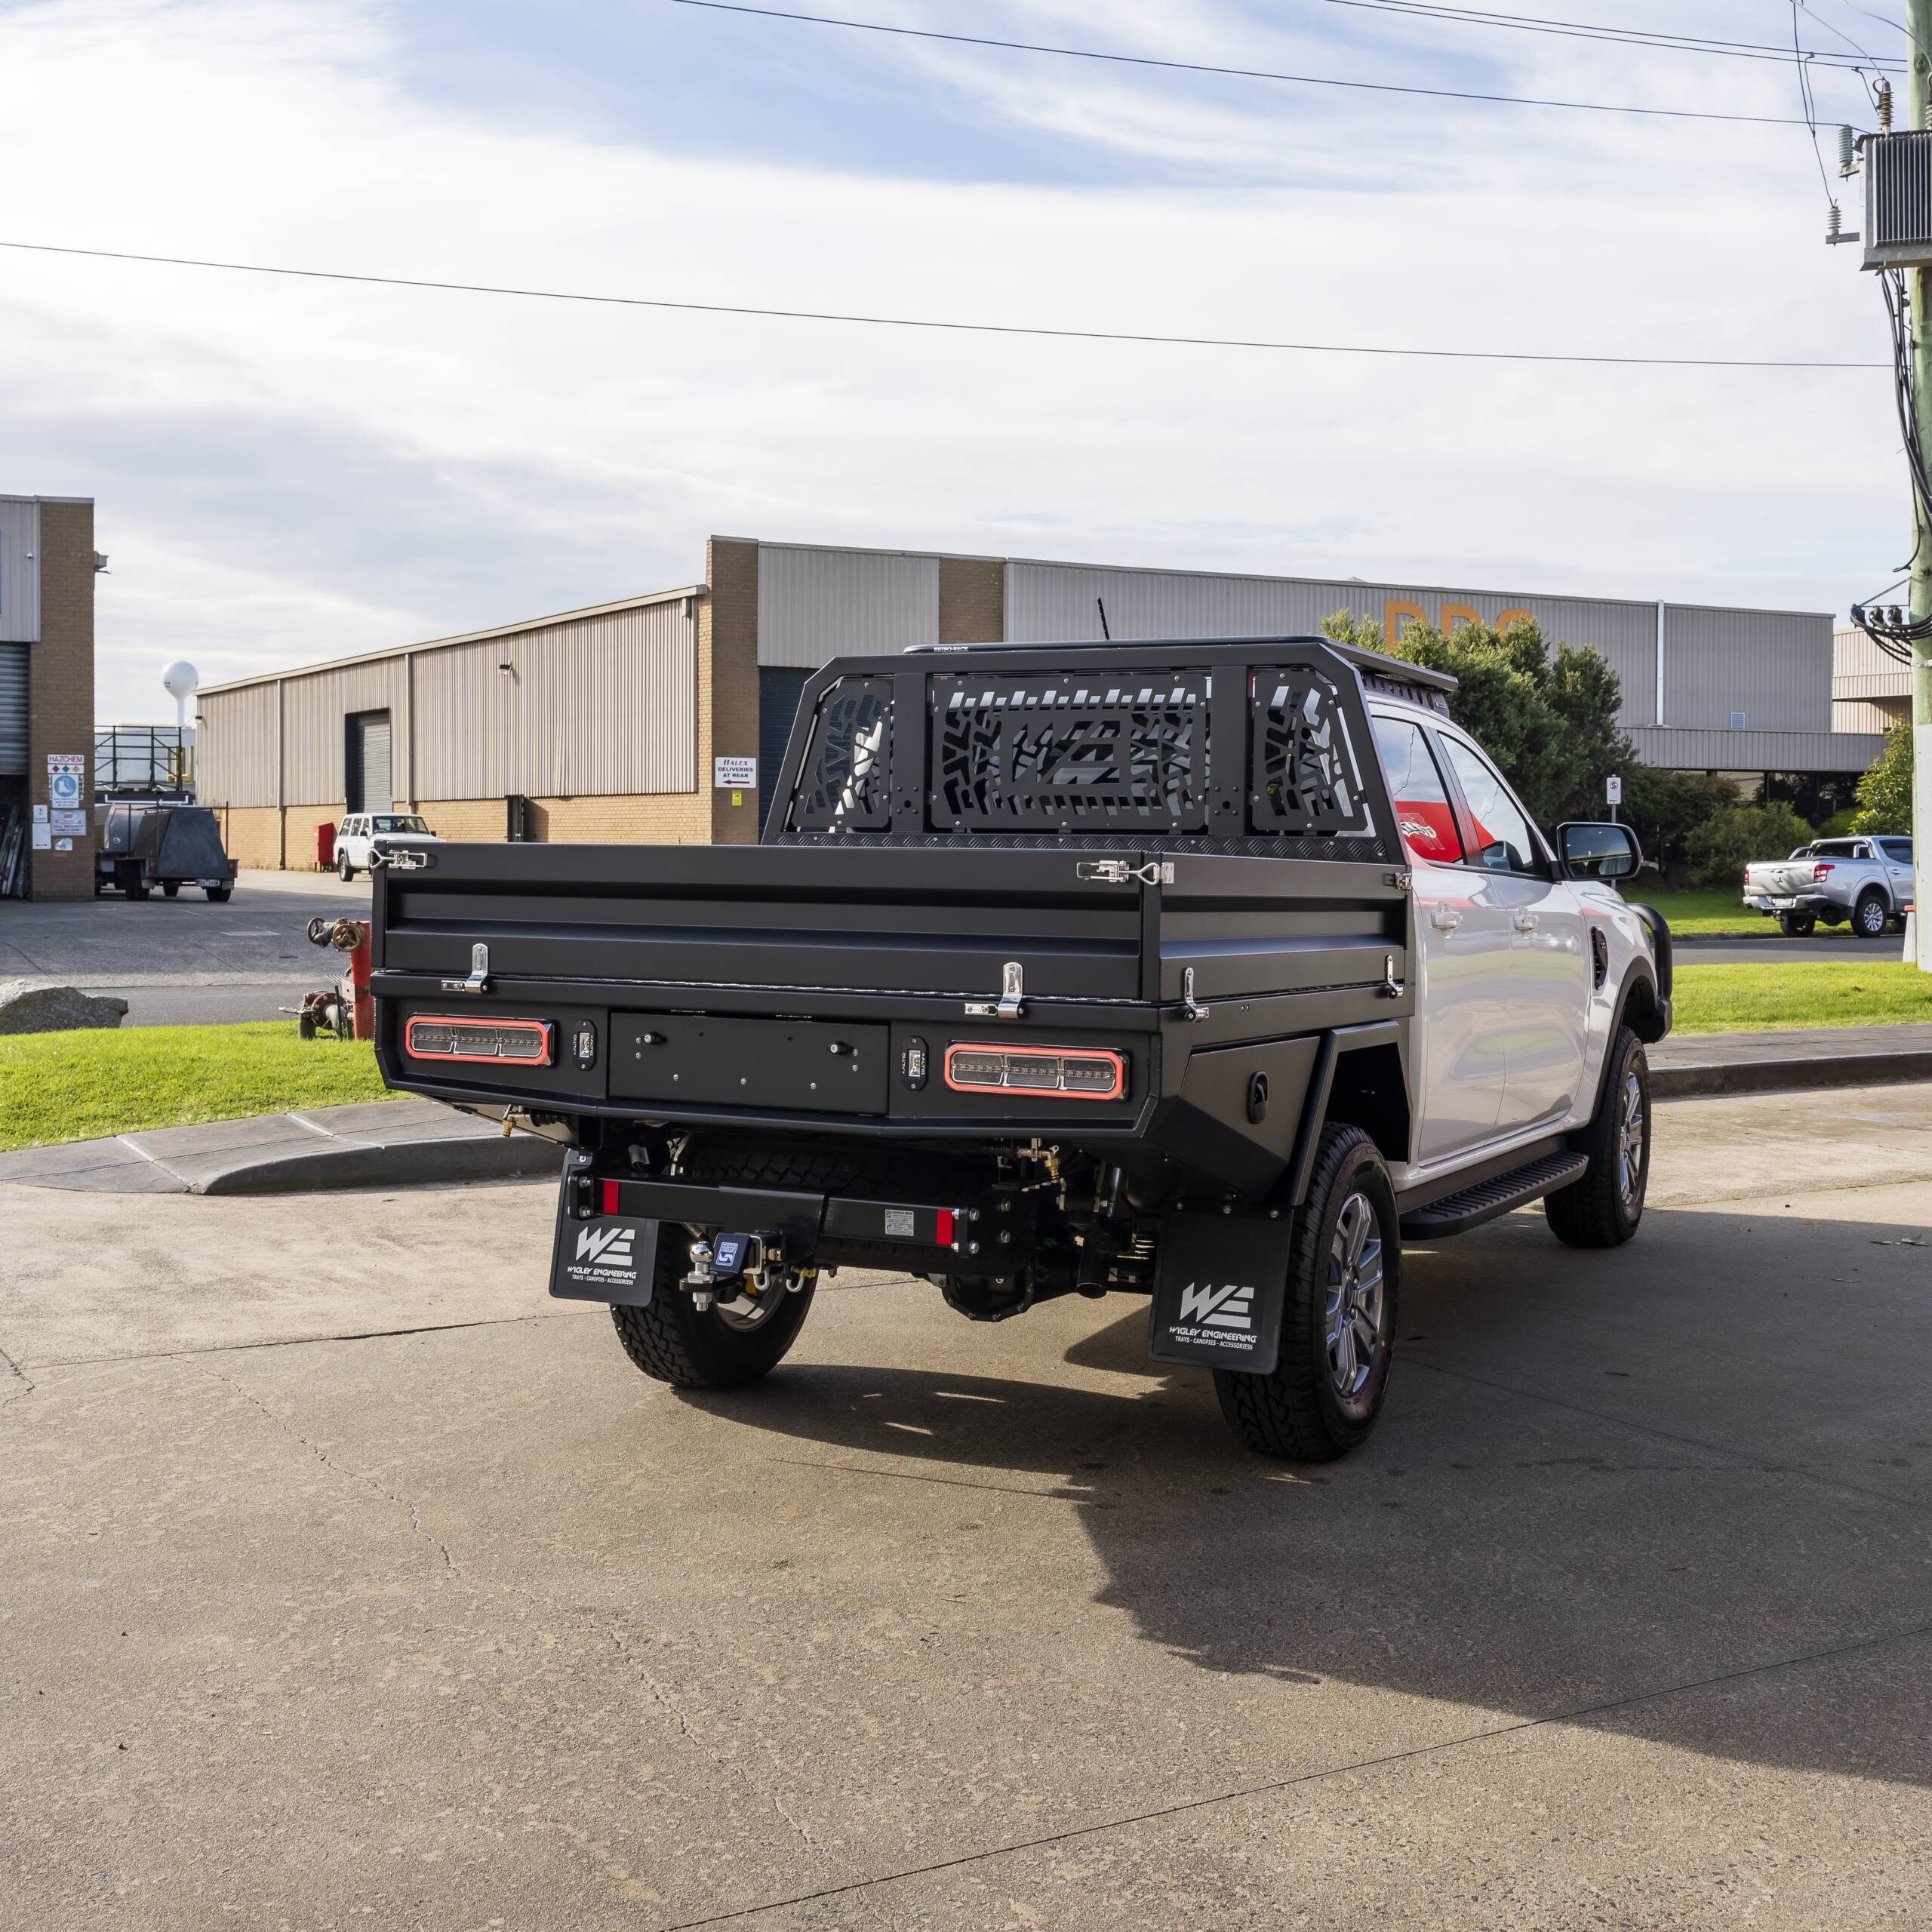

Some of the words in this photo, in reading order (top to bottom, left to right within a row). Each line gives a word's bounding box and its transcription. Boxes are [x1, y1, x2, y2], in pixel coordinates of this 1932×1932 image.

[575, 1226, 635, 1266] WE
[567, 1266, 593, 1275] WIGLEY
[593, 1268, 638, 1279] ENGINEERING
[1180, 1282, 1254, 1329] WE
[1169, 1326, 1201, 1337] WIGLEY
[1201, 1330, 1258, 1343] ENGINEERING
[1193, 1338, 1217, 1346] CANOPIES
